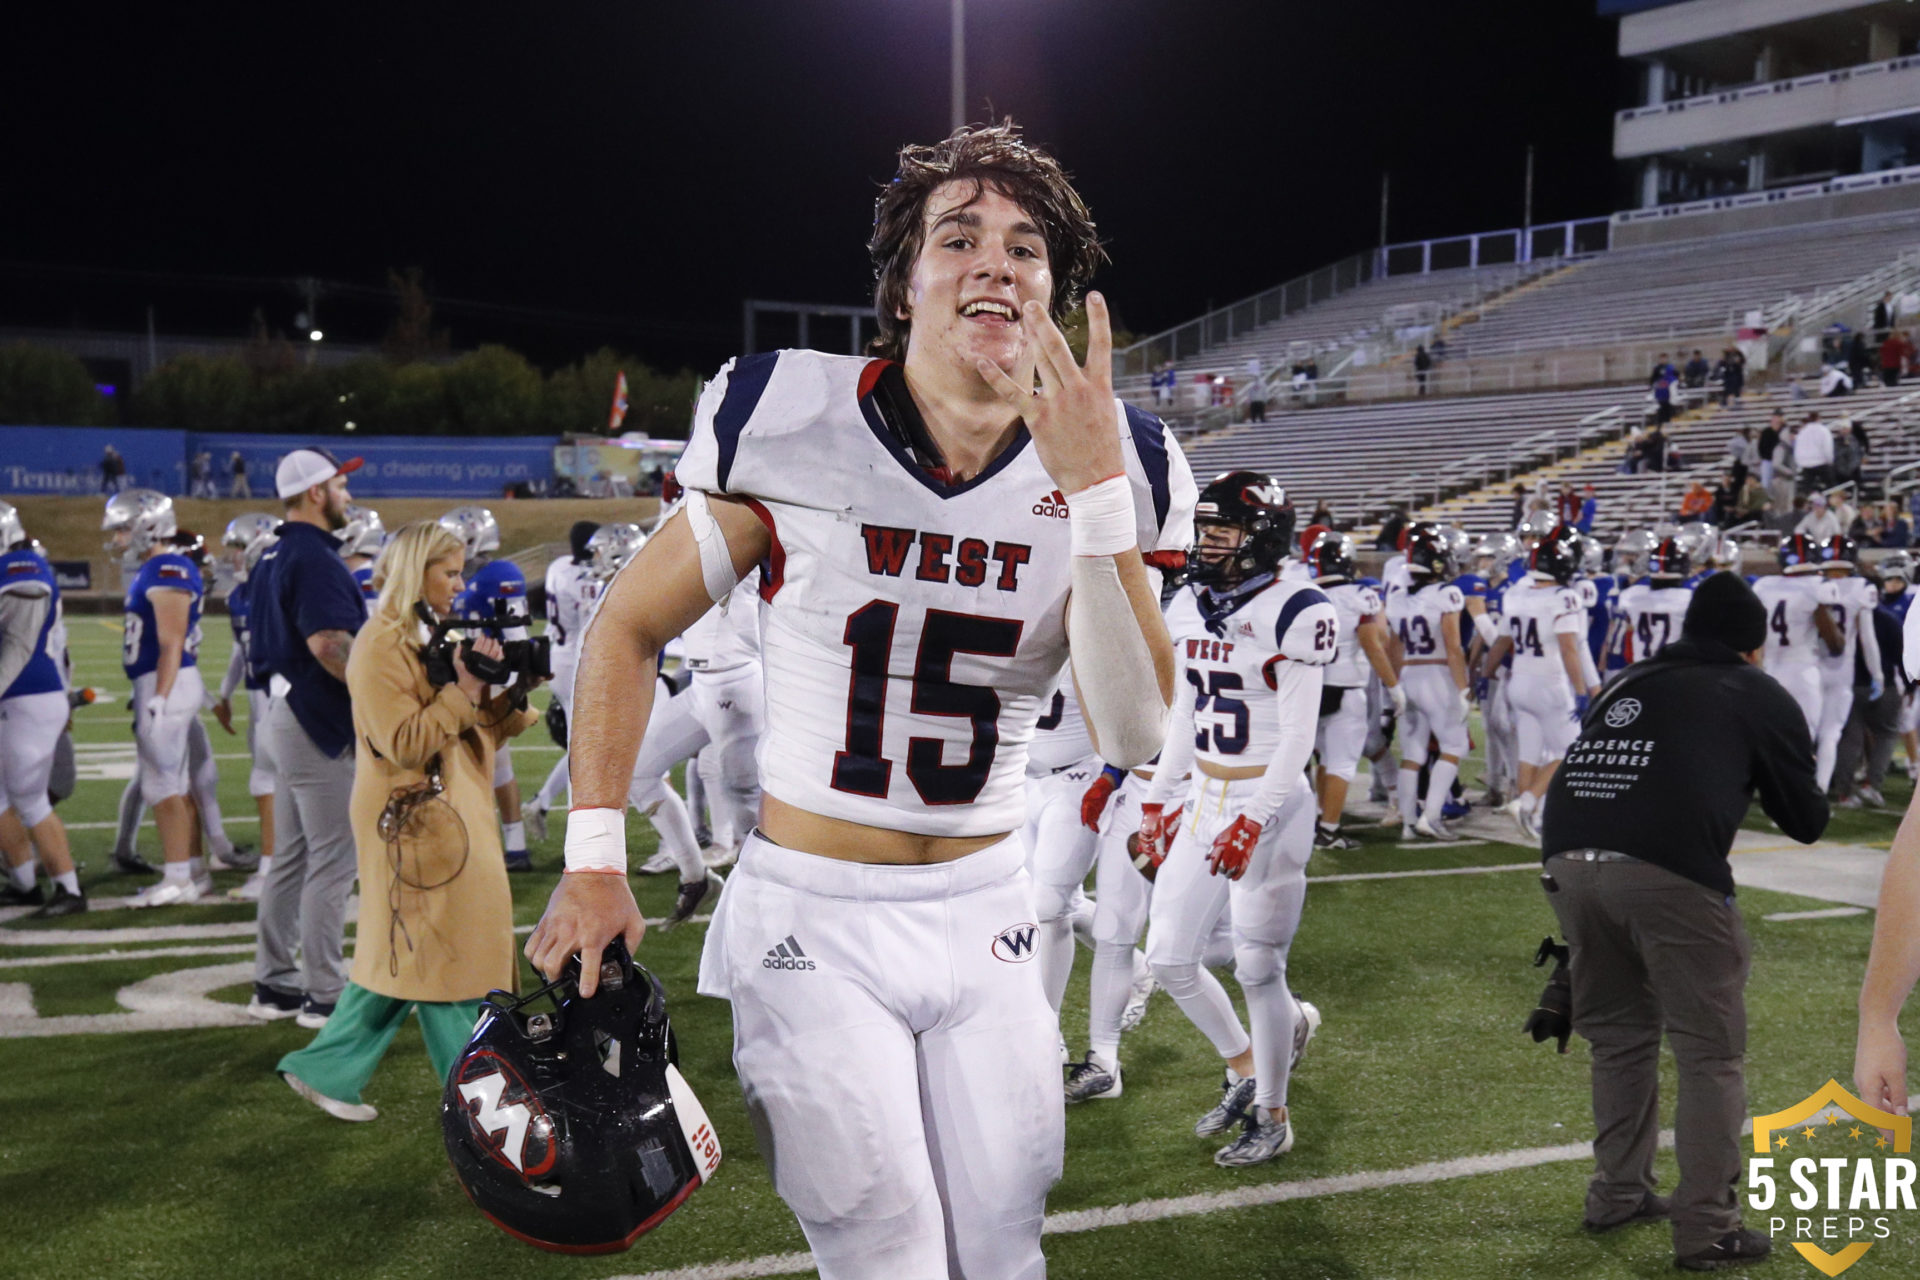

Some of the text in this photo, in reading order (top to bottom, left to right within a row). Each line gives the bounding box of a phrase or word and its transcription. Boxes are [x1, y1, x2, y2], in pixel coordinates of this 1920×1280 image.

[382, 459, 463, 481] cheering
[467, 463, 500, 481] you
[861, 523, 1032, 592] WEST
[1314, 618, 1336, 651] 25
[1510, 616, 1544, 657] 34
[1637, 612, 1671, 658] 47
[1186, 639, 1235, 663] WEST
[830, 598, 1025, 806] 15
[1187, 668, 1250, 755] 25
[1566, 753, 1650, 767] CAPTURES
[1573, 790, 1617, 799] SERVICES
[997, 926, 1036, 958] W
[762, 956, 816, 971] adidas
